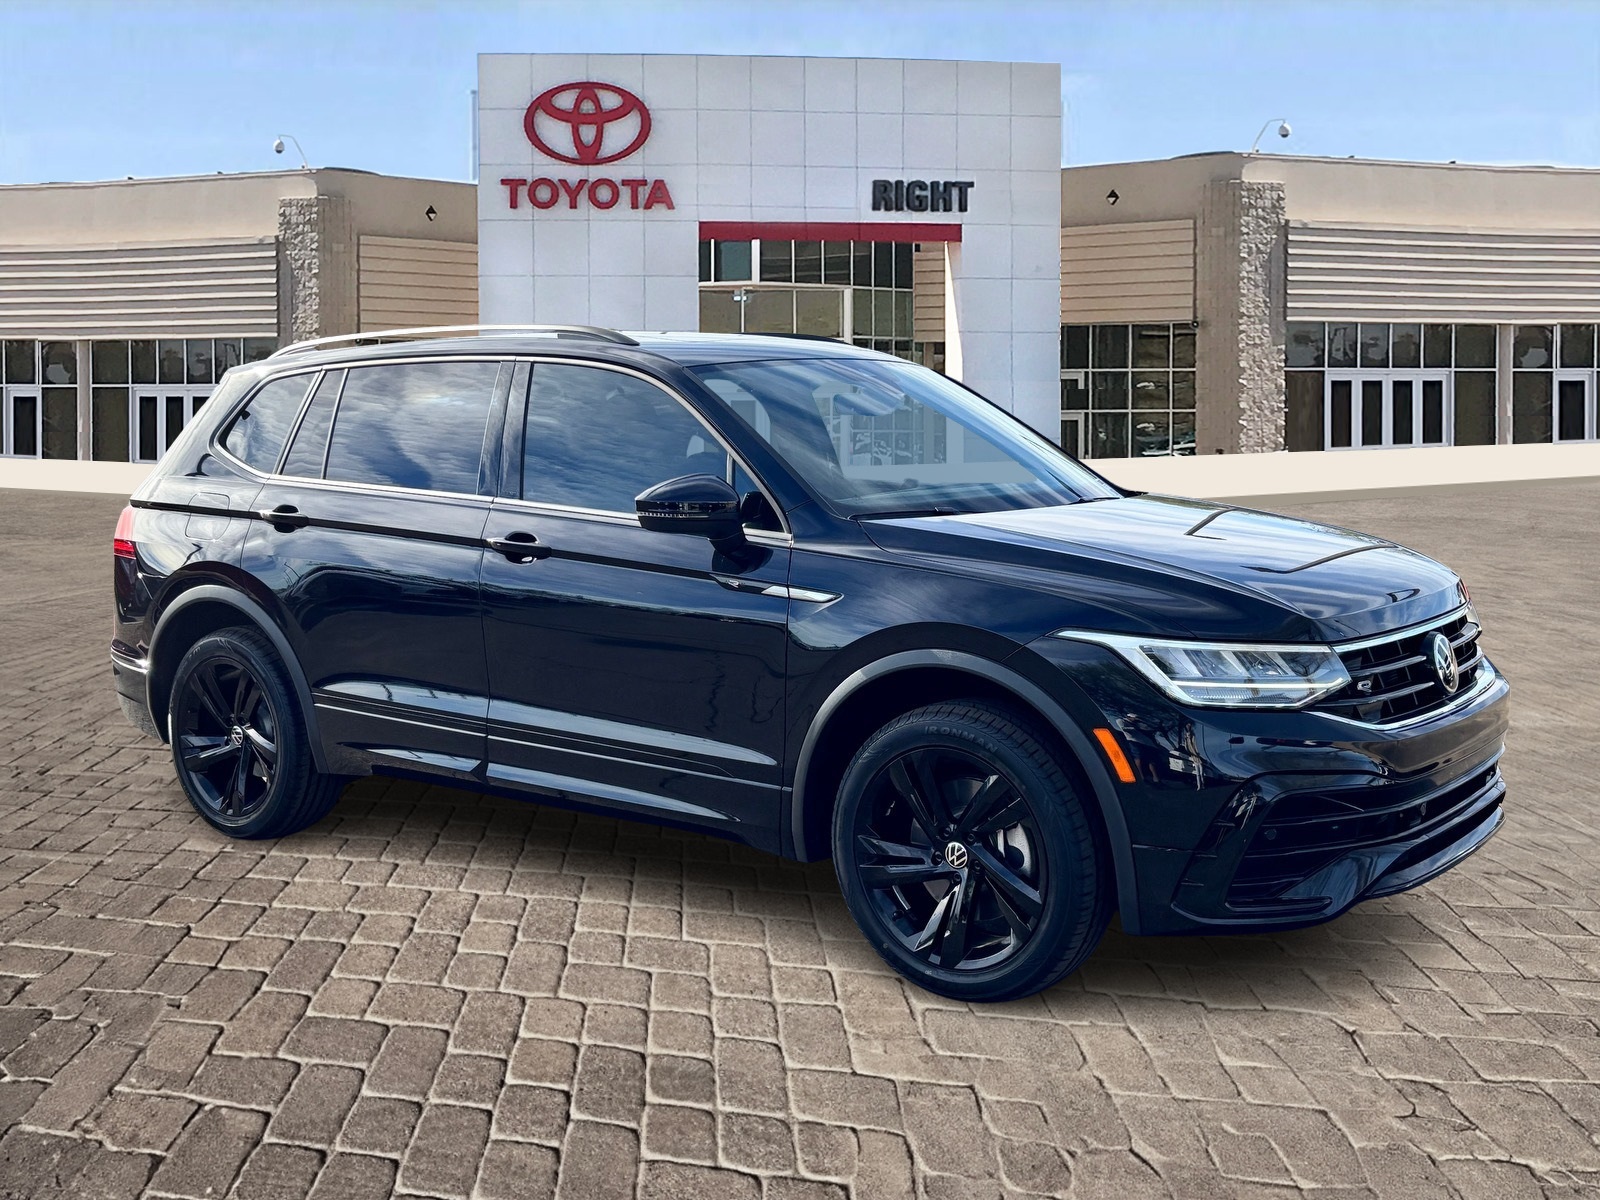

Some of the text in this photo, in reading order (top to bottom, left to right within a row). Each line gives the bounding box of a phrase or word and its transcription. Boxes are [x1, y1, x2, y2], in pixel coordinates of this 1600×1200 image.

[500, 177, 676, 210] TOYOTA
[871, 179, 975, 213] RIGHT
[924, 725, 999, 753] IRONMAN
